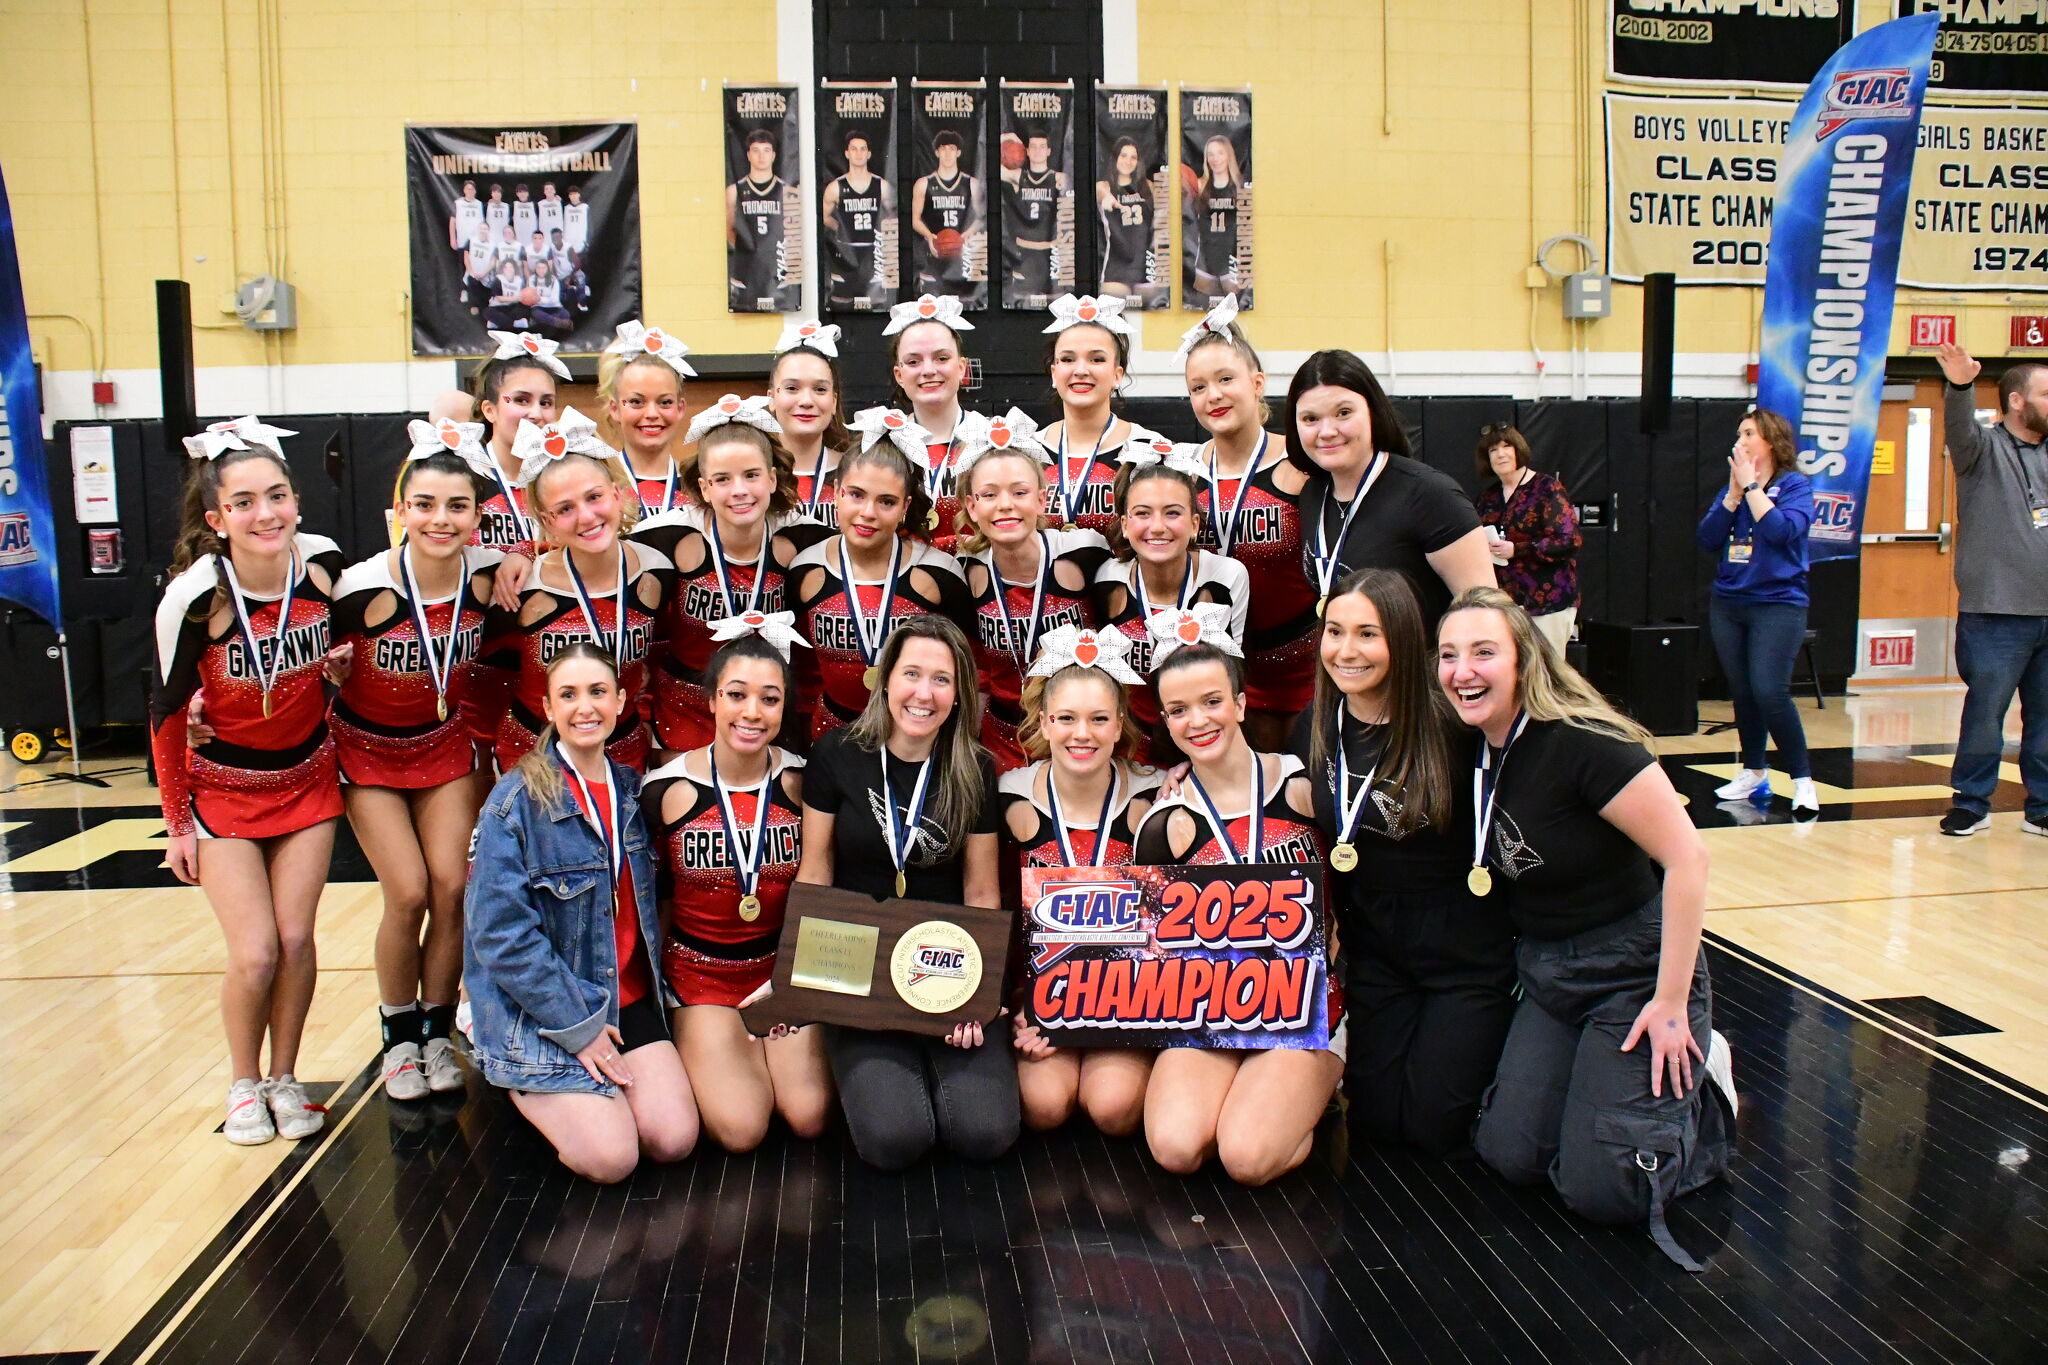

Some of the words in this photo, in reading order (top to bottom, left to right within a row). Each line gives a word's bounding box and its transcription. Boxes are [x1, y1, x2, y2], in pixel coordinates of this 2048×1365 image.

[1619, 16, 1660, 39] 2001
[1666, 21, 1709, 41] 2002
[1948, 32, 1991, 51] 74-75
[1838, 76, 1911, 105] CIAC
[736, 96, 787, 113] EAGLES
[835, 96, 885, 112] EAGLES
[925, 96, 974, 112] EAGLES
[1013, 96, 1062, 112] EAGLES
[1108, 98, 1156, 115] EAGLES
[1192, 100, 1240, 116] EAGLES
[1634, 114, 1686, 142] BOYS
[1917, 125, 1970, 150] GIRLS
[1984, 127, 2048, 151] BASKE
[495, 135, 549, 153] EAGLES
[432, 154, 500, 174] UNIFIED
[503, 151, 612, 173] BASKETBALL
[1656, 155, 1777, 182] CLASS
[1939, 163, 2048, 190] CLASS
[854, 213, 872, 231] 22
[943, 210, 959, 227] 15
[1030, 202, 1040, 219] 2
[1120, 204, 1144, 226] 23
[1210, 212, 1226, 232] 11
[1629, 191, 1701, 227] STATE
[1712, 194, 1774, 228] CHAM
[1915, 199, 1982, 233] STATE
[1991, 202, 2048, 234] CHAM
[757, 216, 768, 235] 5
[783, 184, 802, 285] RODRIGUEZ
[776, 240, 788, 281] TYLER
[873, 229, 884, 281] HAYDEN
[1692, 240, 1770, 266] 200
[1973, 246, 2048, 272] 1974
[1146, 250, 1157, 284] ABBY
[1228, 255, 1239, 285] LILY
[1796, 134, 1888, 478] CHAMPIONSHIPS
[1917, 317, 1952, 345] EXIT
[1813, 501, 1854, 528] AC
[0, 520, 30, 551] AC
[1875, 638, 1909, 664] EXIT
[1049, 892, 1140, 926] CIAC
[1156, 879, 1311, 947] 2025
[920, 949, 965, 969] CIAC
[1033, 956, 1313, 1028] CHAMPION
